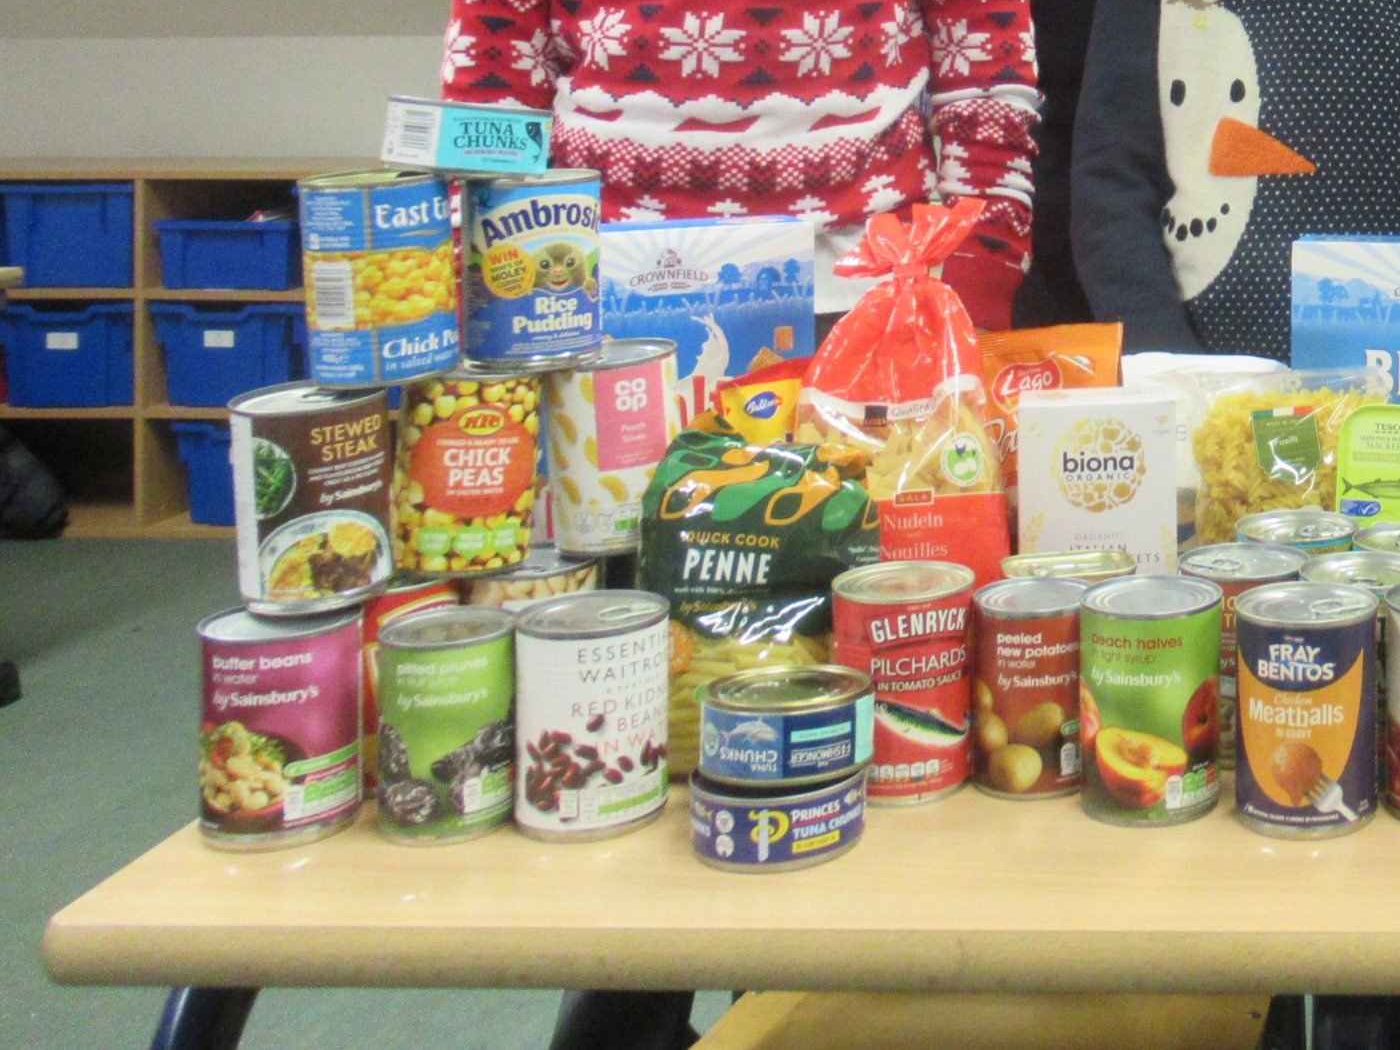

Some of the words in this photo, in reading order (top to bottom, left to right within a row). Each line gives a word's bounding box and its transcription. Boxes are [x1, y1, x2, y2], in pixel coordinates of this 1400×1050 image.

[460, 121, 513, 135] TUNA
[453, 135, 528, 150] CHUNKS
[374, 200, 431, 229] East
[490, 249, 519, 265] WIN
[491, 267, 527, 282] MOLEY
[629, 268, 709, 288] CROWNFIELD
[535, 296, 578, 314] Rice
[512, 311, 593, 334] Pudding
[382, 332, 439, 358] Chick
[1001, 370, 1053, 396] Lago
[310, 414, 381, 445] STEWED
[321, 433, 378, 462] STEAK
[443, 447, 512, 467] CHICK
[1063, 452, 1134, 473] biona
[448, 467, 505, 487] PEAS
[1066, 472, 1130, 482] ORGANIC
[884, 512, 944, 530] Nudeln
[686, 530, 730, 545] QUICK
[735, 533, 780, 548] COOK
[1074, 532, 1123, 541] ORGANIC
[880, 543, 948, 561] Nouilles
[682, 548, 772, 585] PENNE
[871, 607, 966, 643] GLENRYCK
[997, 633, 1042, 645] peeled
[1137, 635, 1183, 650] halves
[870, 644, 966, 676] PILCHARDS
[997, 646, 1021, 657] new
[1126, 652, 1156, 665] syrup
[1268, 644, 1320, 663] FRAY
[212, 655, 256, 671] butter
[259, 652, 313, 670] beans
[579, 652, 661, 682] WAITRO
[1258, 659, 1335, 681] BENTOS
[878, 682, 888, 691] IN
[891, 677, 935, 692] TOMATO
[937, 668, 961, 685] SAUCE
[1013, 671, 1077, 688] Sainsbury's
[1108, 669, 1182, 687] Sainsbury's
[213, 689, 231, 711] by
[230, 684, 320, 708] Sainsbury's
[571, 699, 618, 718] RED
[1250, 697, 1344, 727] Meatballs
[720, 746, 778, 763] CHUNKS
[751, 763, 777, 772] TUNA
[791, 799, 840, 822] PRINCES
[792, 822, 827, 840] TUNA
